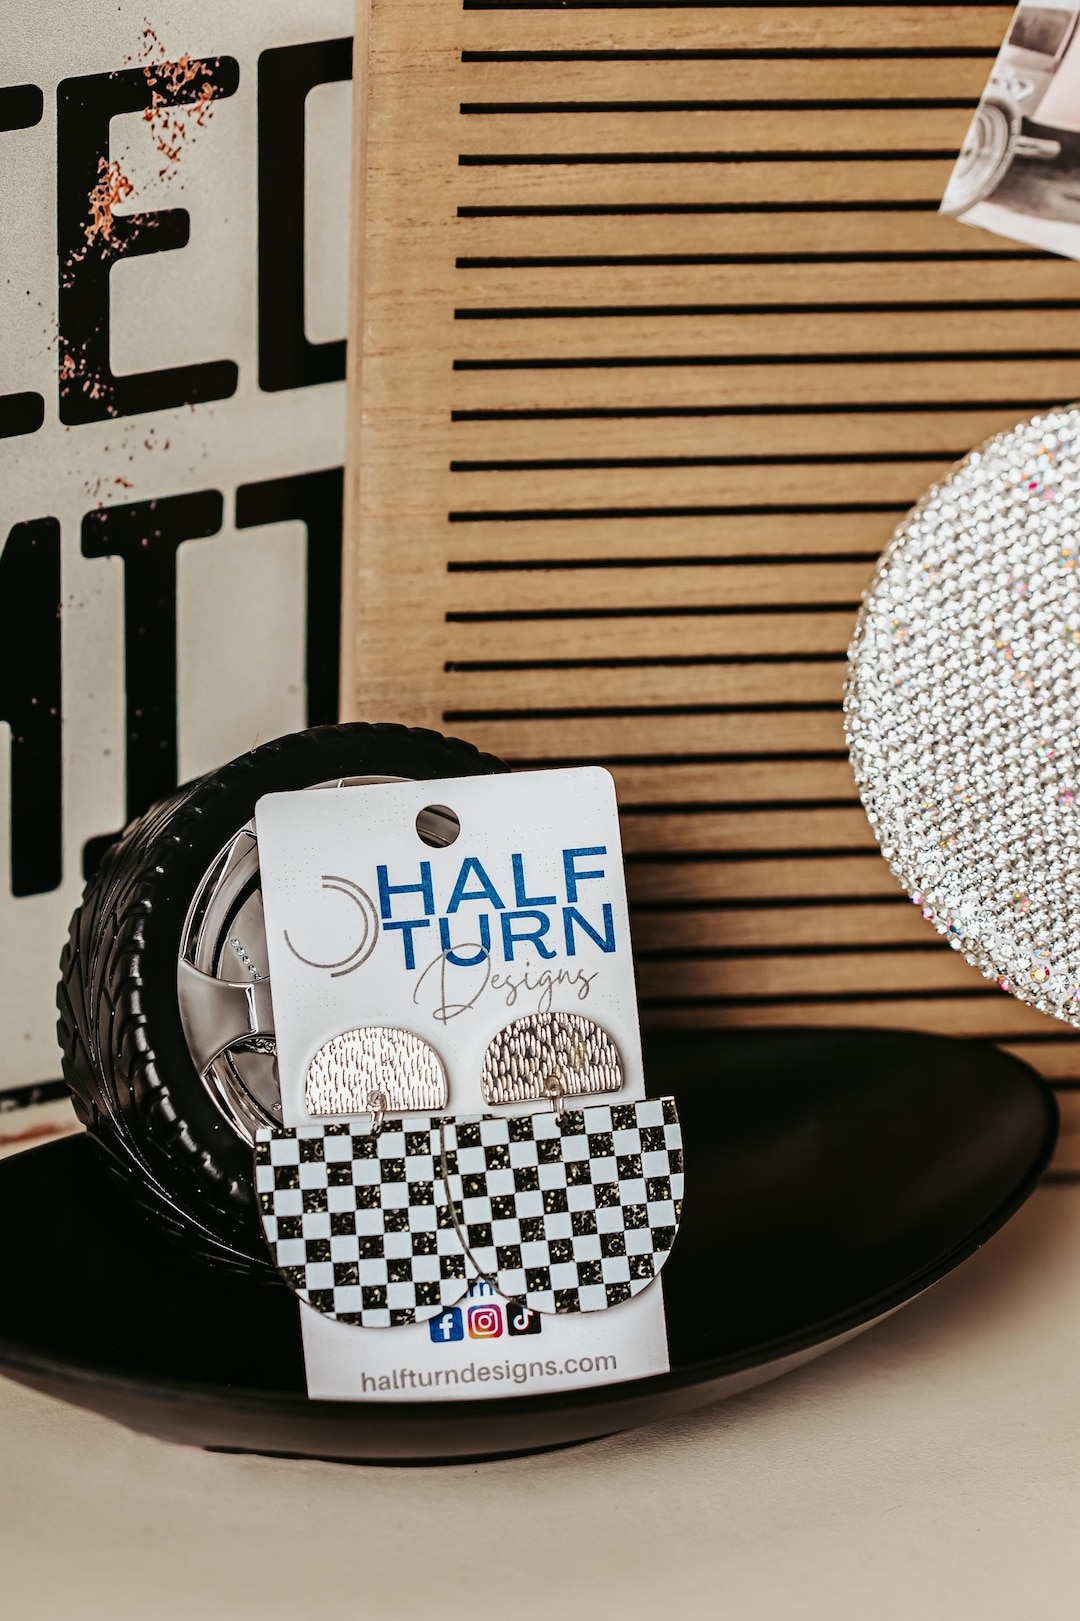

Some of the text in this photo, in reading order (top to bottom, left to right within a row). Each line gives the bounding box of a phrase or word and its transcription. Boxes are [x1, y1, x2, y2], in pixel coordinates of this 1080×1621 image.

[375, 845, 608, 919] HALF
[382, 903, 617, 970] TURN
[413, 942, 599, 1025] Designs
[361, 1354, 618, 1393] halfturndesigns.com
